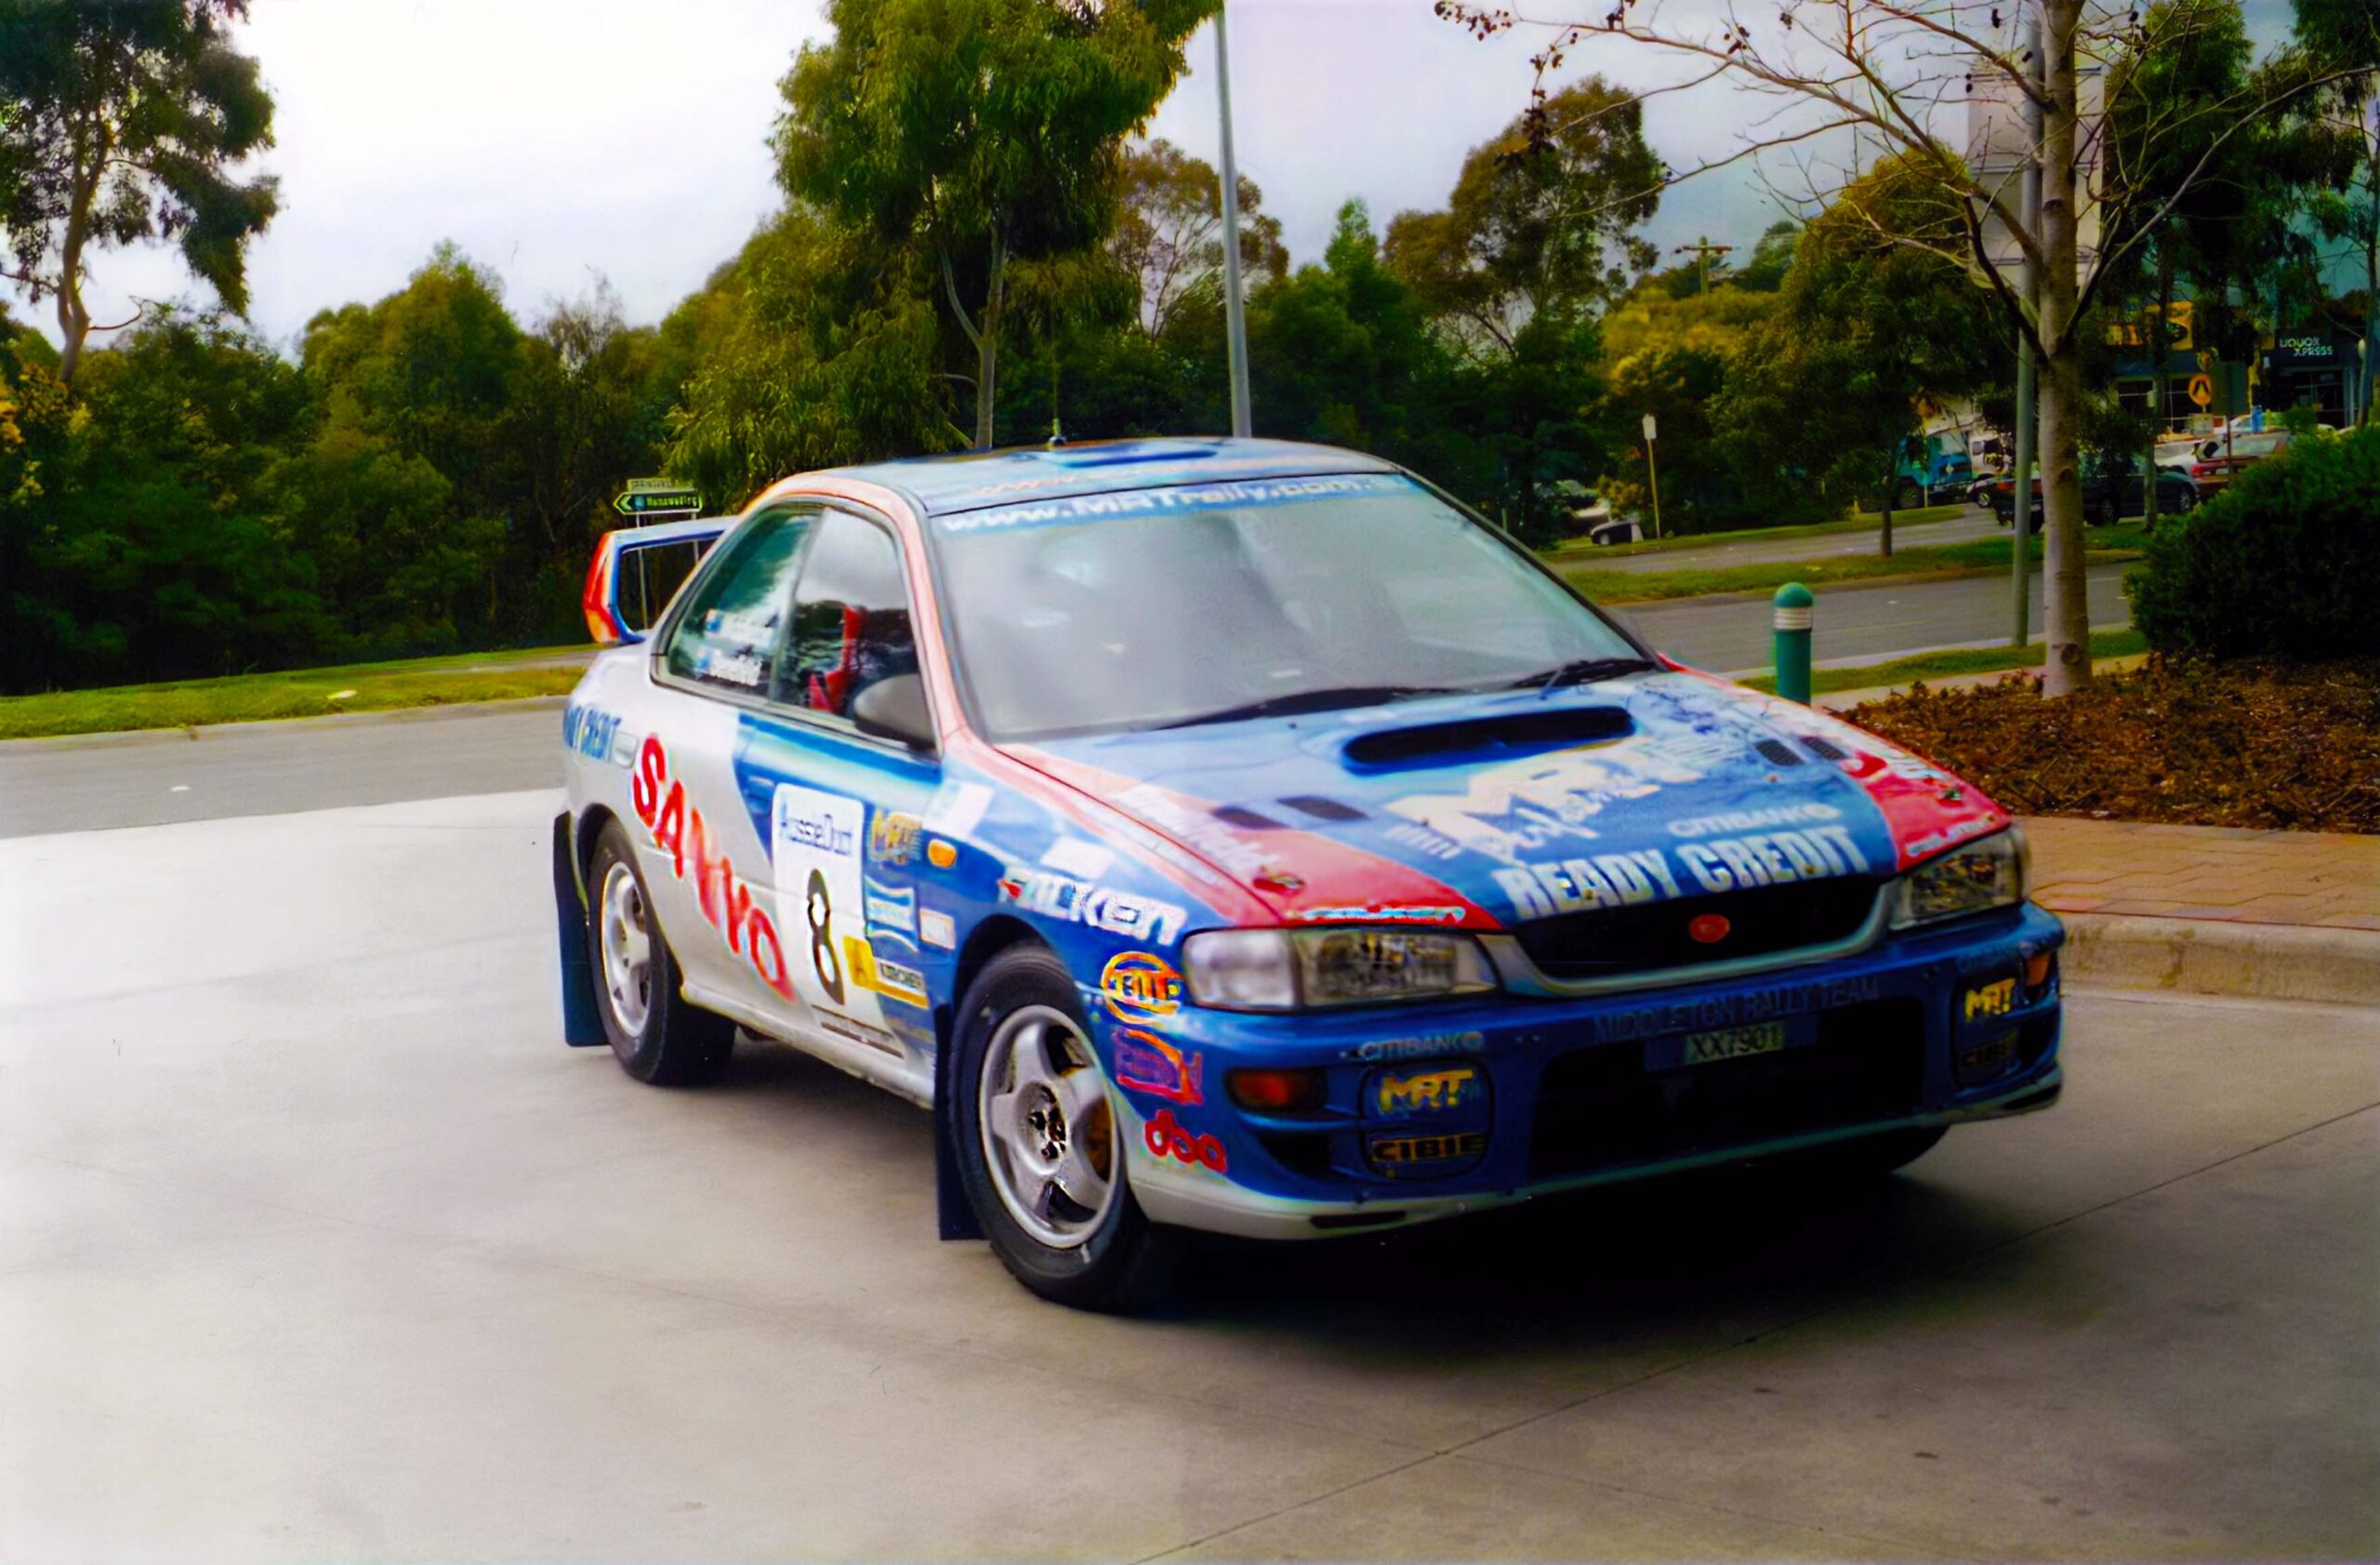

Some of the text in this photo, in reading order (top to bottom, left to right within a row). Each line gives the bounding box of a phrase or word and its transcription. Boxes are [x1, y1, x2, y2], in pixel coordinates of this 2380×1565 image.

[1491, 847, 1682, 922] READY
[1674, 825, 1870, 895] CREDIT
[807, 868, 846, 1006] 8
